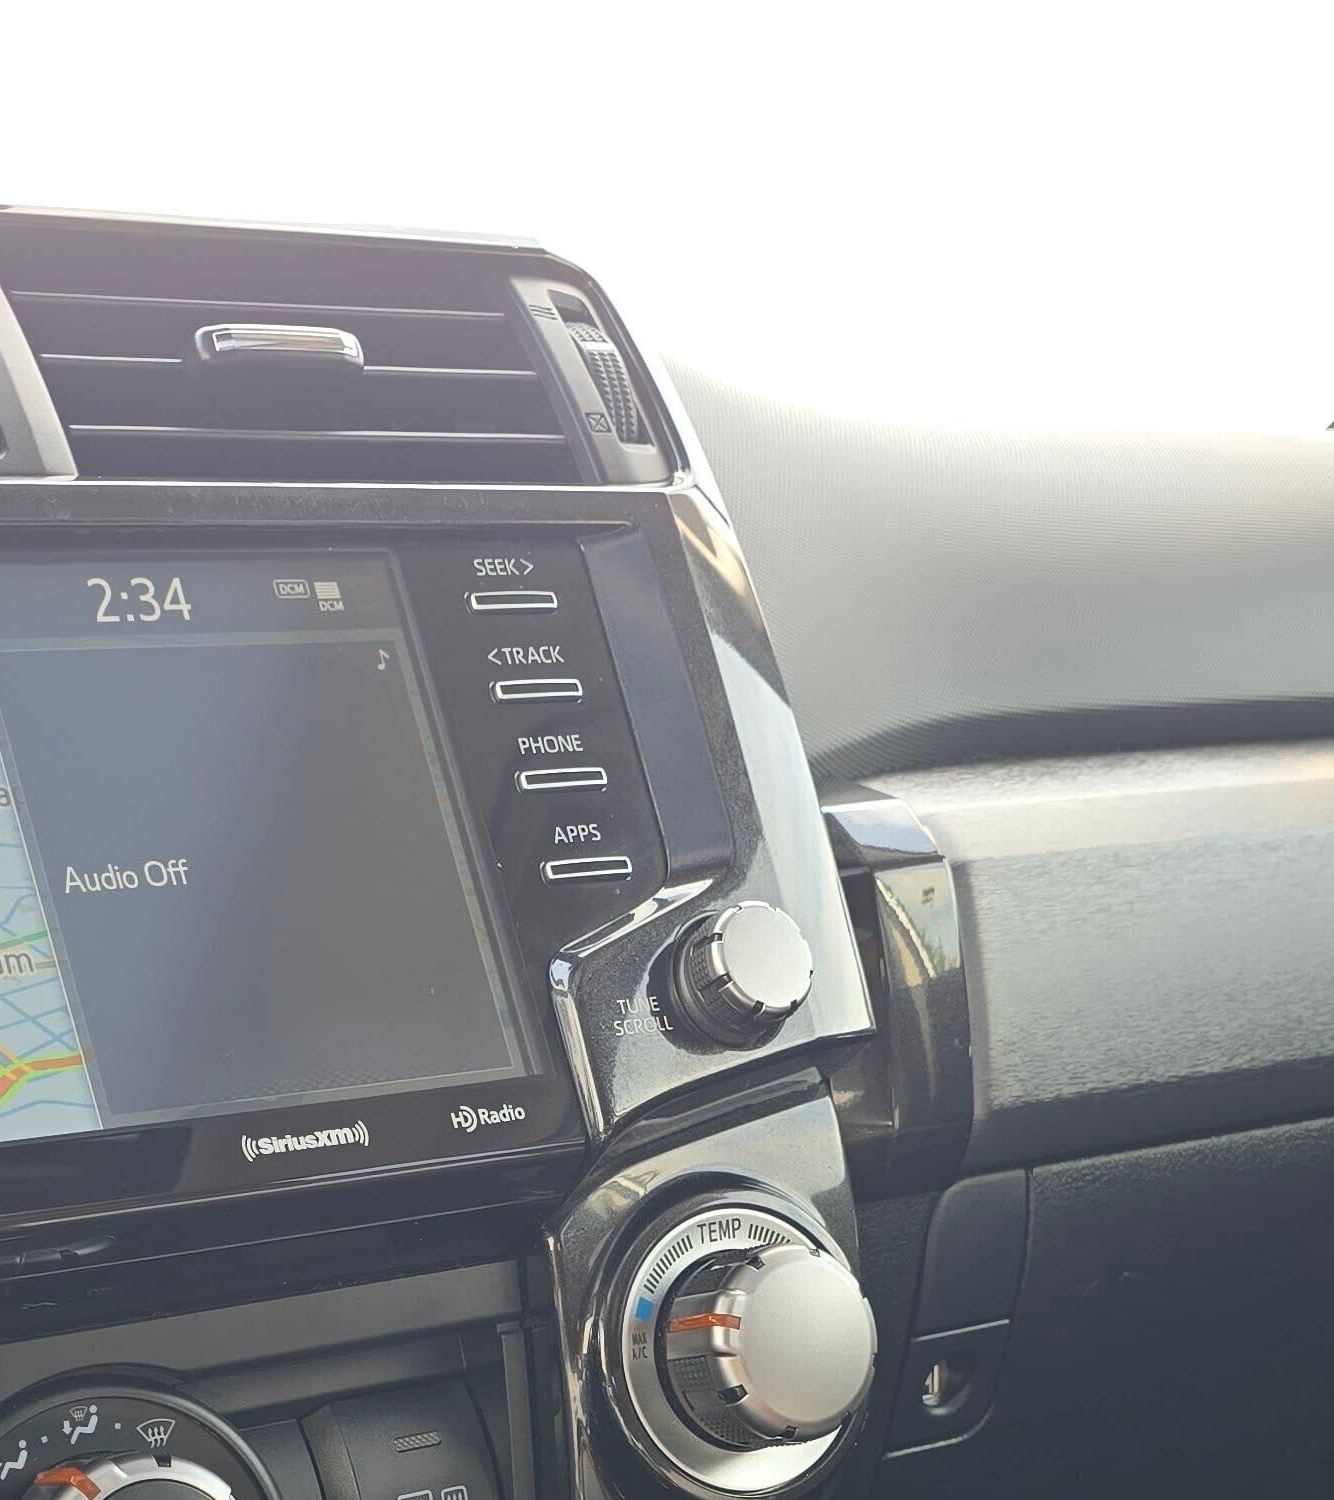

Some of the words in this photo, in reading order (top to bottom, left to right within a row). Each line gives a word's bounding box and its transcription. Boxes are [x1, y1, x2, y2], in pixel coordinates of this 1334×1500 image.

[86, 576, 192, 623] 2:34
[278, 583, 305, 595] DCM
[318, 600, 345, 612] DCM
[517, 734, 584, 755] PHONE
[553, 823, 602, 844] APPS
[64, 862, 139, 893] Audio
[144, 858, 189, 887] Off
[616, 996, 661, 1015] TUNE
[613, 1015, 674, 1036] SCROLL
[478, 1104, 526, 1126] Radio
[697, 1217, 742, 1245] TEMP
